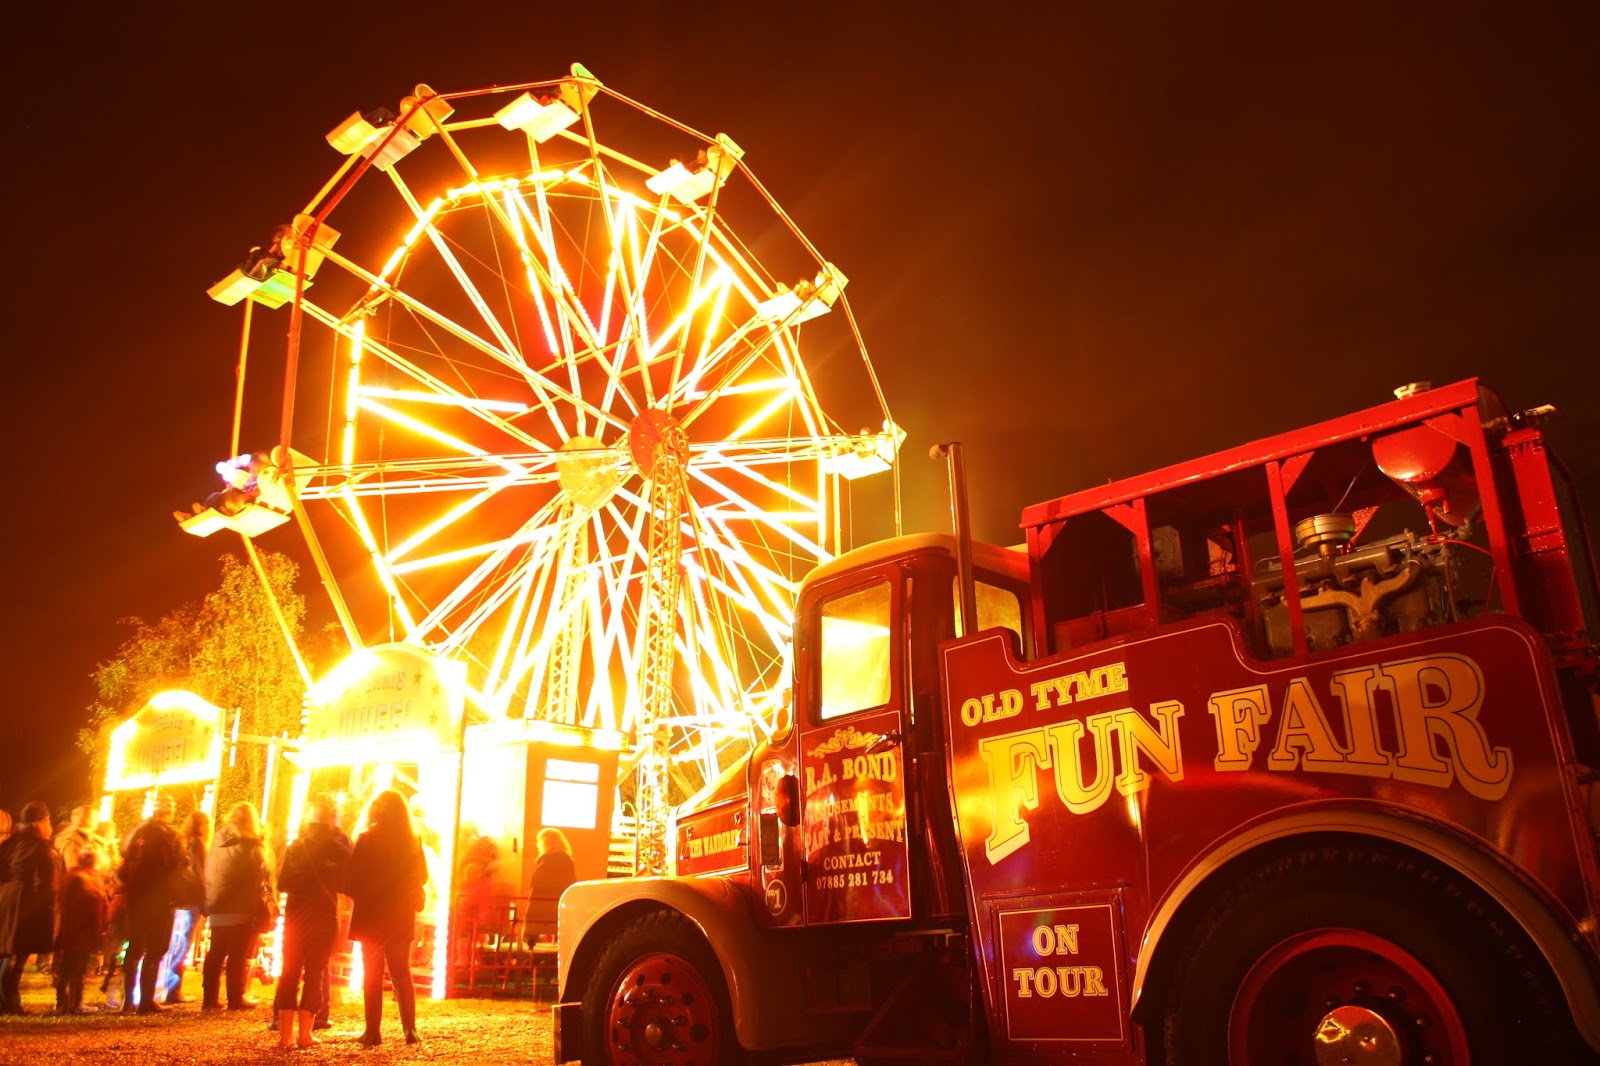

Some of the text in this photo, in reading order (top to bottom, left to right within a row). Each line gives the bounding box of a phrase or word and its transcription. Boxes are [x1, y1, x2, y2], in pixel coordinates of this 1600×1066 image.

[961, 662, 1129, 727] OLD TYME
[805, 751, 897, 796] R.A. BOND
[978, 652, 1514, 865] FUN FAIR
[806, 791, 894, 826] USEMNTS
[805, 820, 904, 858] PAST & PRSENT
[823, 850, 882, 870] CONTACT
[816, 869, 894, 890] 07885 281 734
[1032, 923, 1080, 957] ON
[1012, 965, 1109, 998] TOUR
